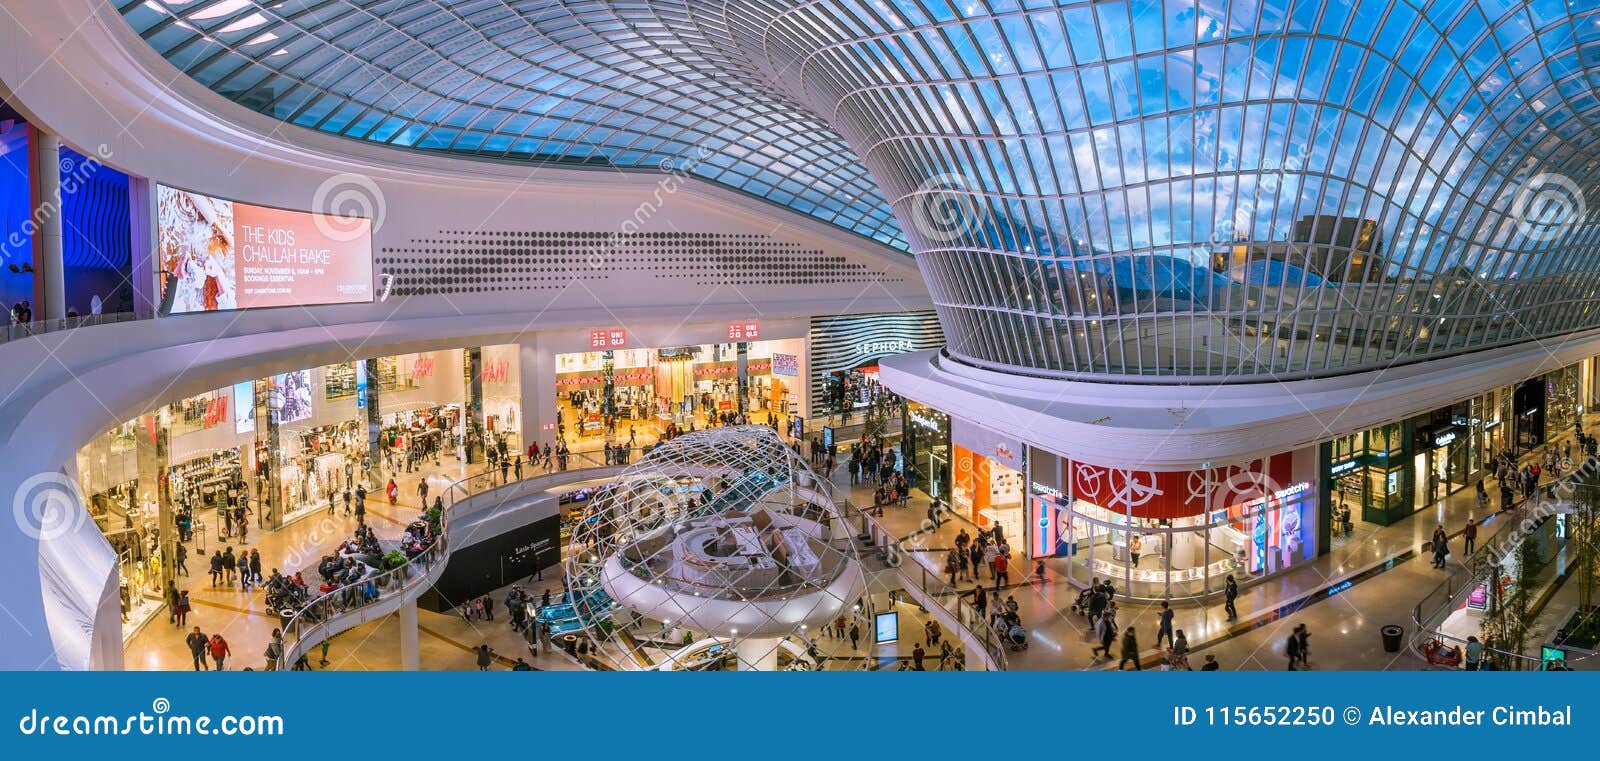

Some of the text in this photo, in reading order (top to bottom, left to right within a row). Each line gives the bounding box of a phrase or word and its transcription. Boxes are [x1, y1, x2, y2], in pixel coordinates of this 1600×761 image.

[242, 225, 295, 246] THE KIDS
[242, 245, 331, 264] CHALLAH BAKE
[611, 338, 625, 346] QLO
[856, 338, 913, 354] SEPHORA
[481, 360, 509, 384] H&M
[1032, 481, 1059, 498] swatch
[1275, 482, 1304, 499] swatch
